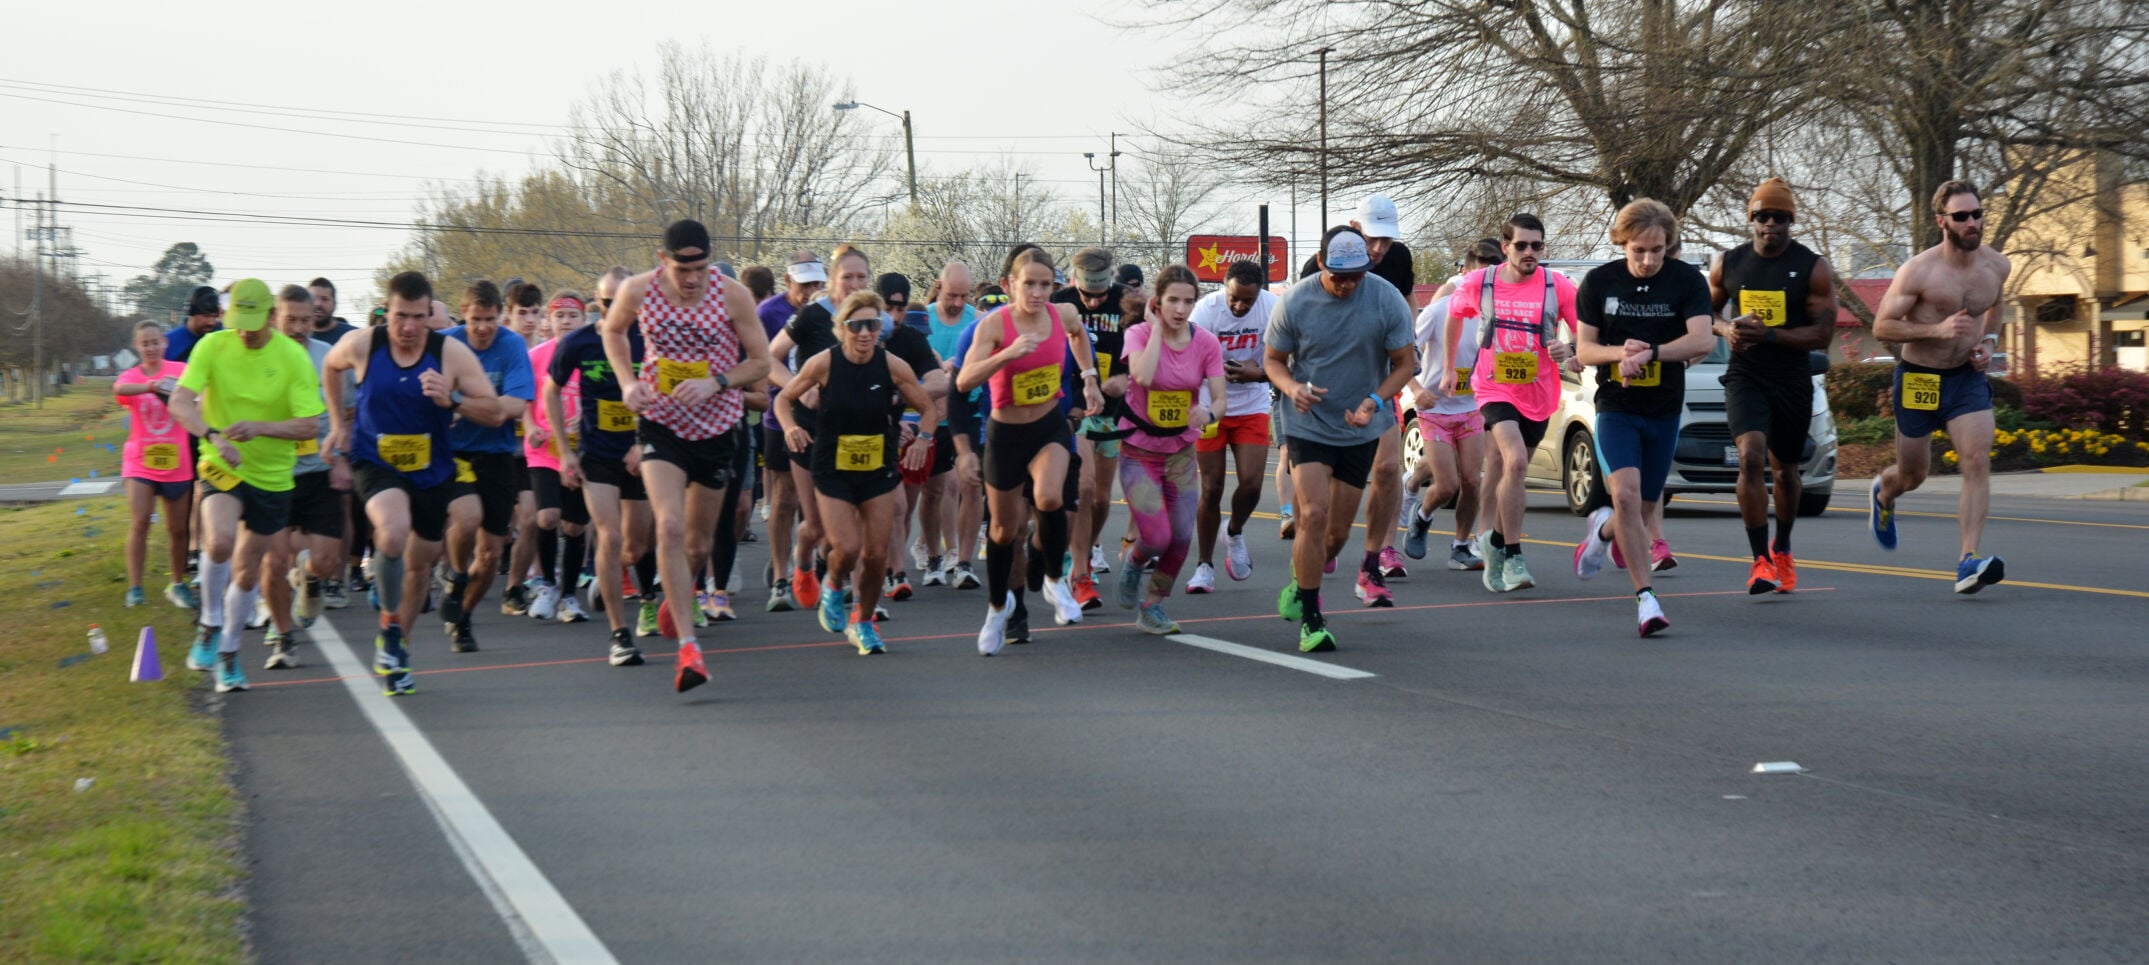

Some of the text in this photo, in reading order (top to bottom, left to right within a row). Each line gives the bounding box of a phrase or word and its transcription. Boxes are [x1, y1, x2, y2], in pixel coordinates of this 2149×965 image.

[1216, 250, 1279, 264] Harde's
[1078, 313, 1120, 333] LTON
[1505, 367, 1527, 380] 928
[1026, 383, 1050, 400] 840
[1914, 391, 1937, 404] 920
[1159, 408, 1181, 421] 882
[850, 452, 870, 465] 941
